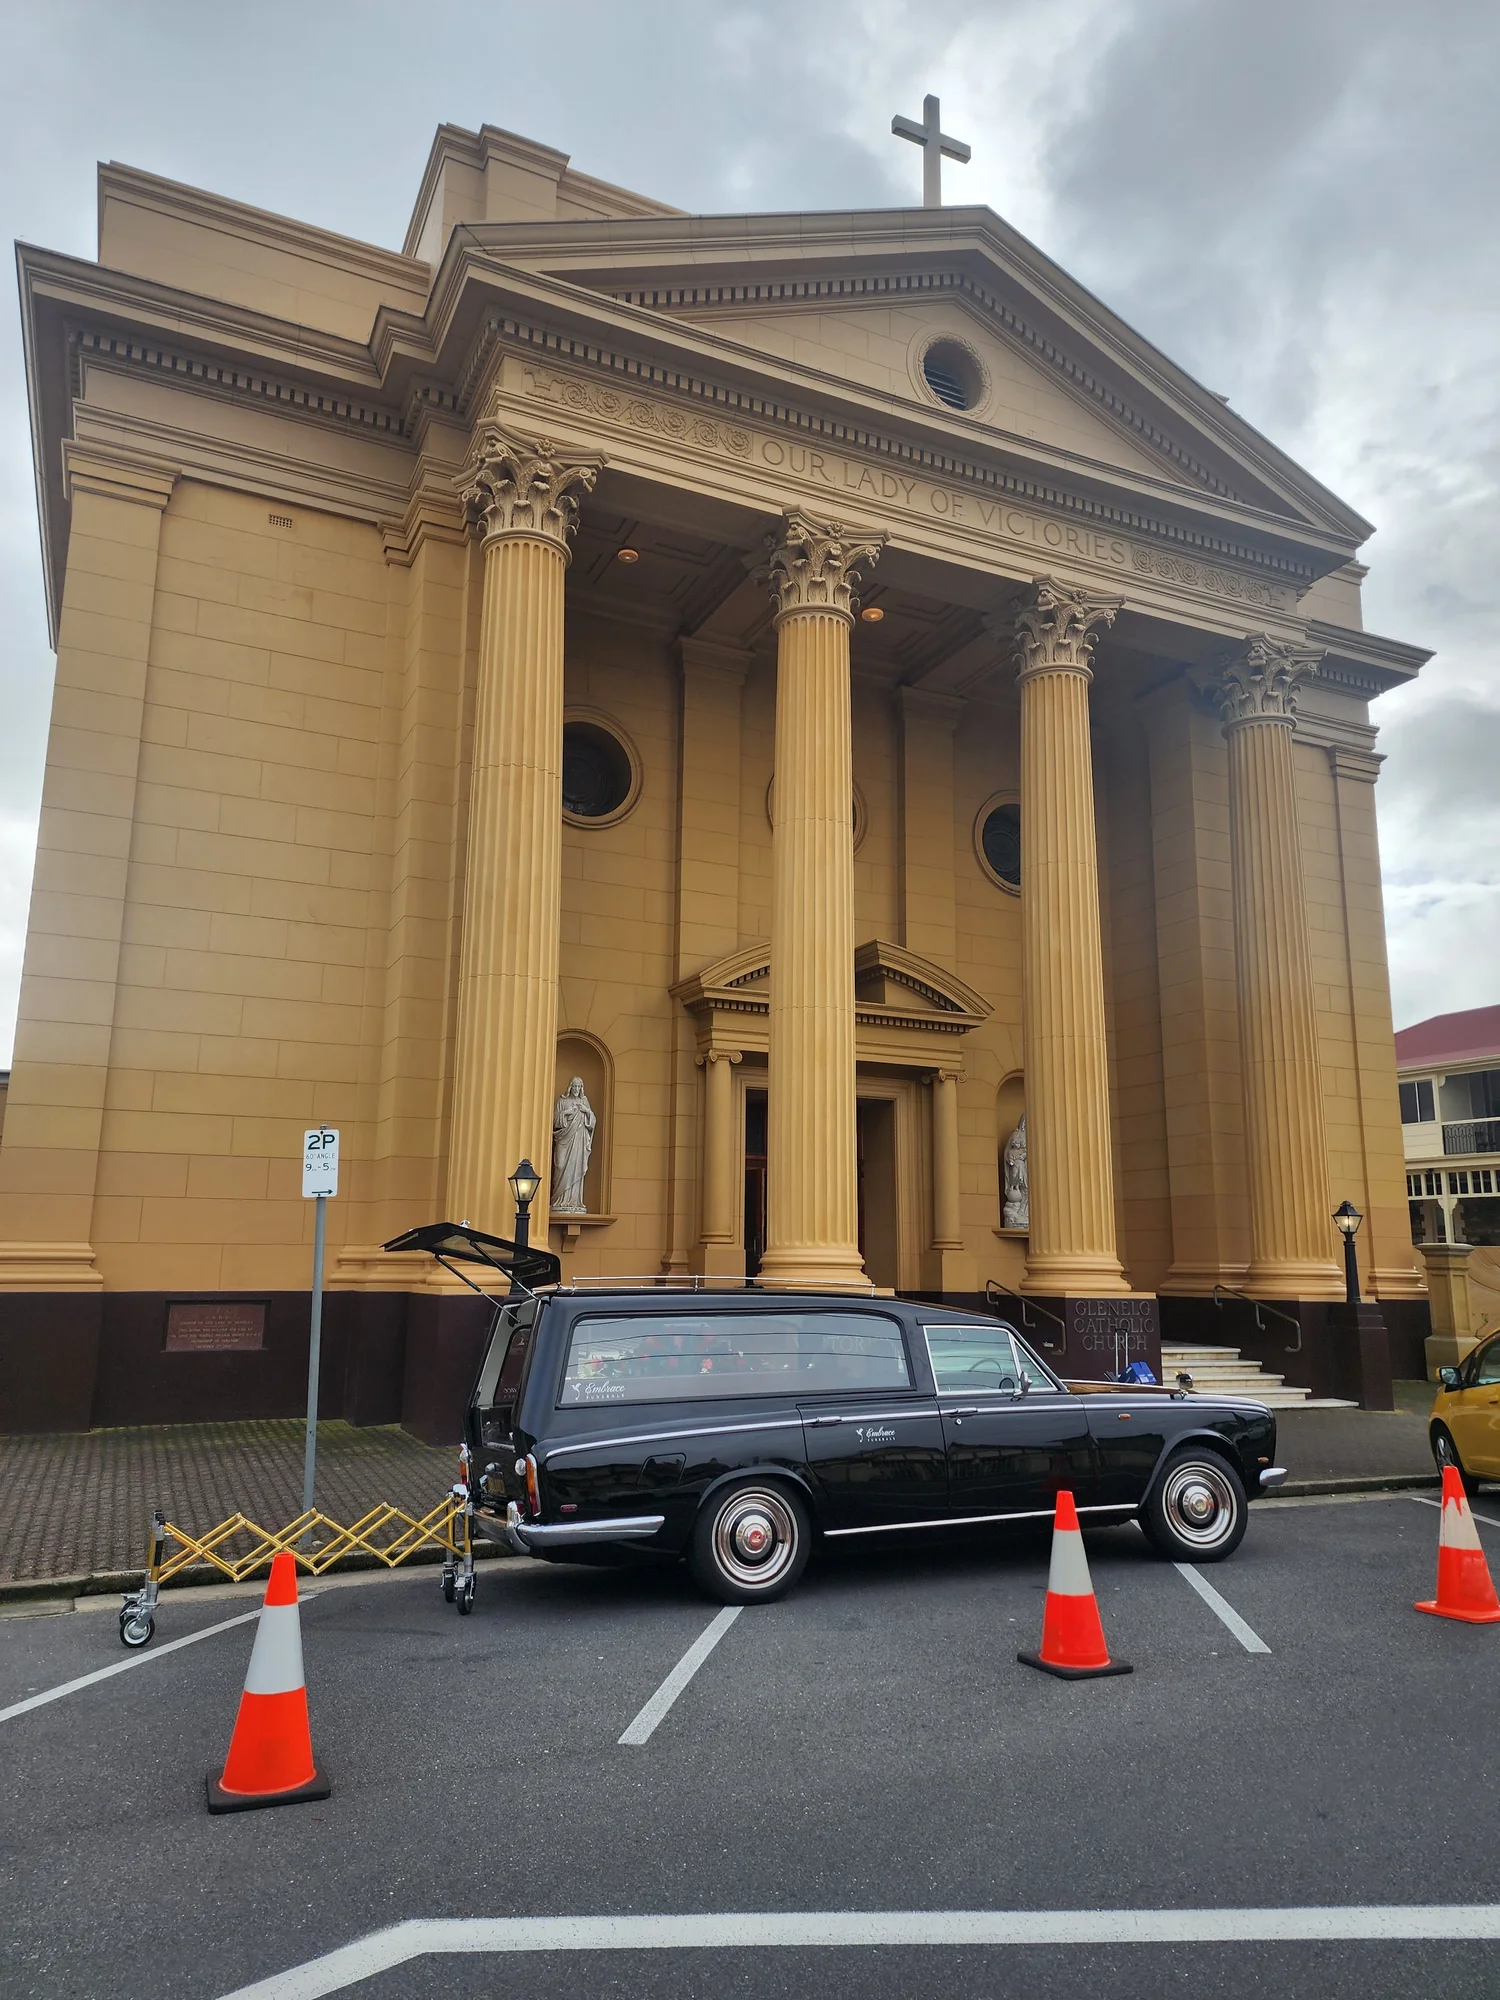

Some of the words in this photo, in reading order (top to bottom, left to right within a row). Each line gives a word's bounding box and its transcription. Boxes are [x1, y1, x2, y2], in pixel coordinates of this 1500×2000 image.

[761, 441, 834, 483] OUR
[842, 462, 917, 505] LADY
[930, 490, 963, 517] OF
[977, 502, 1125, 563] VICTORIES
[308, 1134, 335, 1150] 2P
[1075, 1300, 1151, 1316] GLENELG
[1073, 1317, 1155, 1333] CATHOLIC
[1082, 1335, 1148, 1351] CHURCH
[585, 1380, 626, 1394] Embrace
[866, 1426, 896, 1438] Embrace
